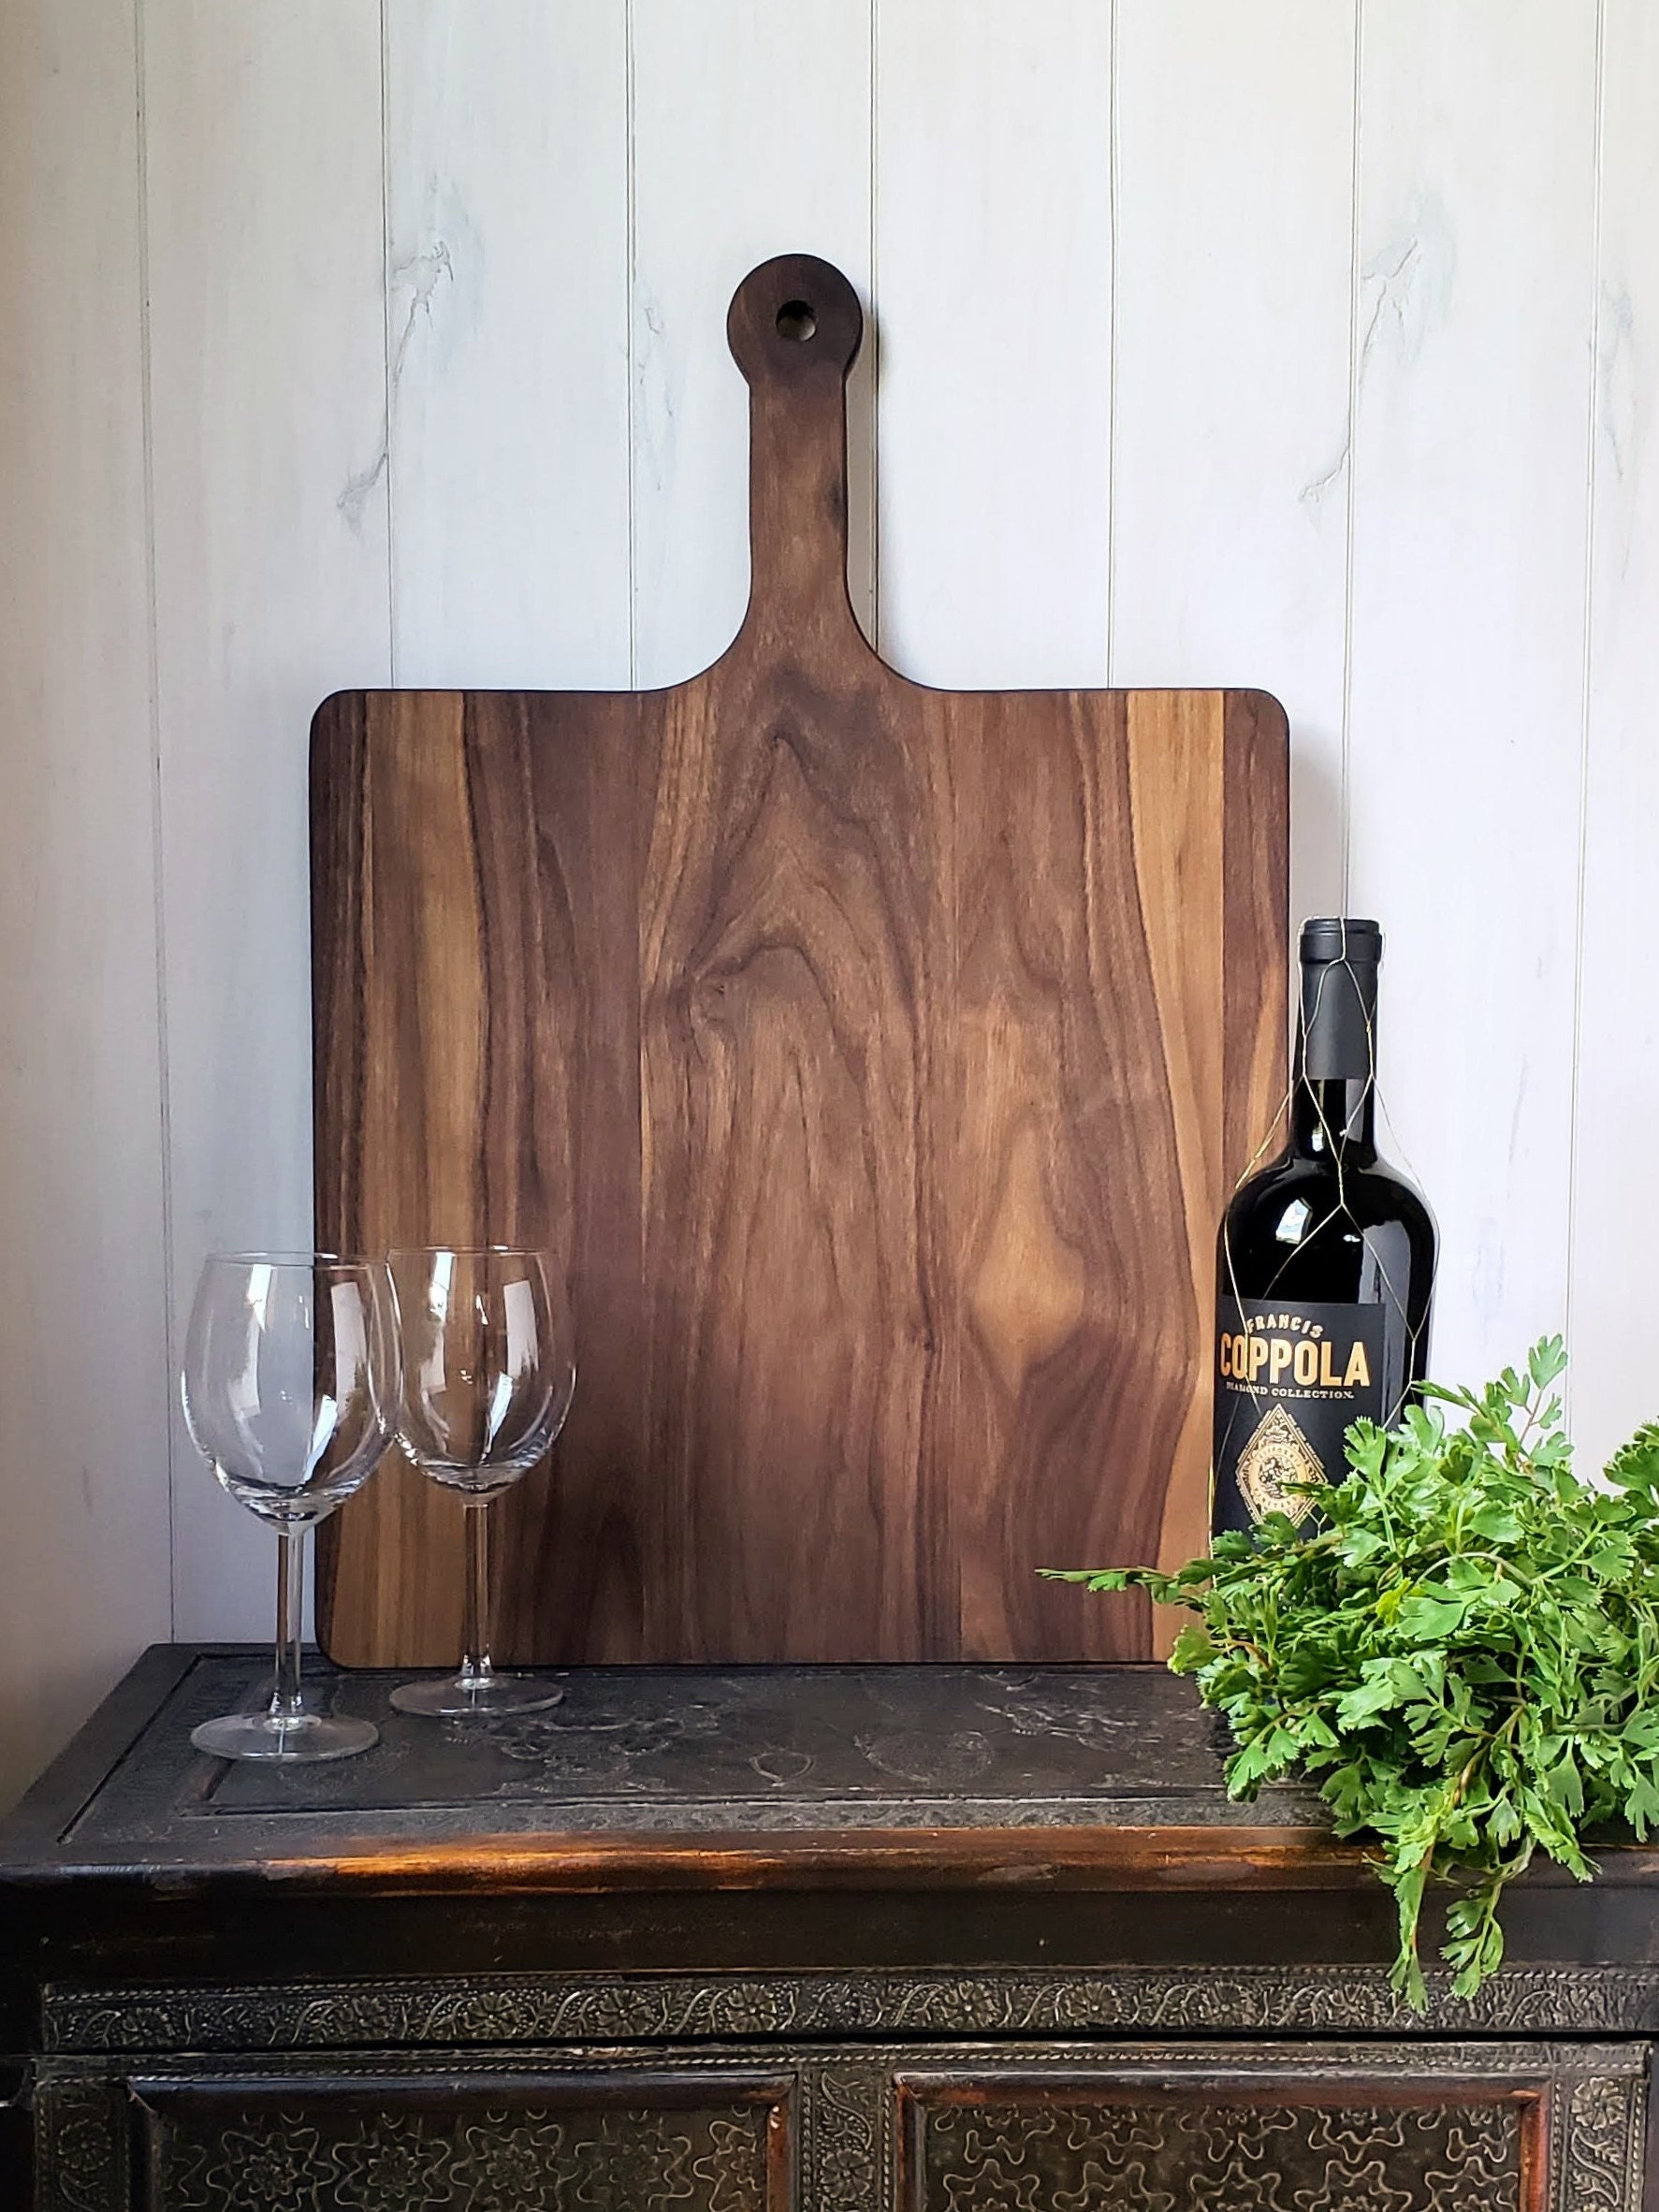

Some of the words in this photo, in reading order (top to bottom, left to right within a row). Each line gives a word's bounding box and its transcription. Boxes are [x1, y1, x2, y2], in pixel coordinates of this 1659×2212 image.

[1247, 1314, 1324, 1338] FRANCIS
[1220, 1332, 1371, 1387] COPPOLA
[1226, 1382, 1268, 1396] DIAMOND
[1271, 1387, 1355, 1400] COLLECTION
